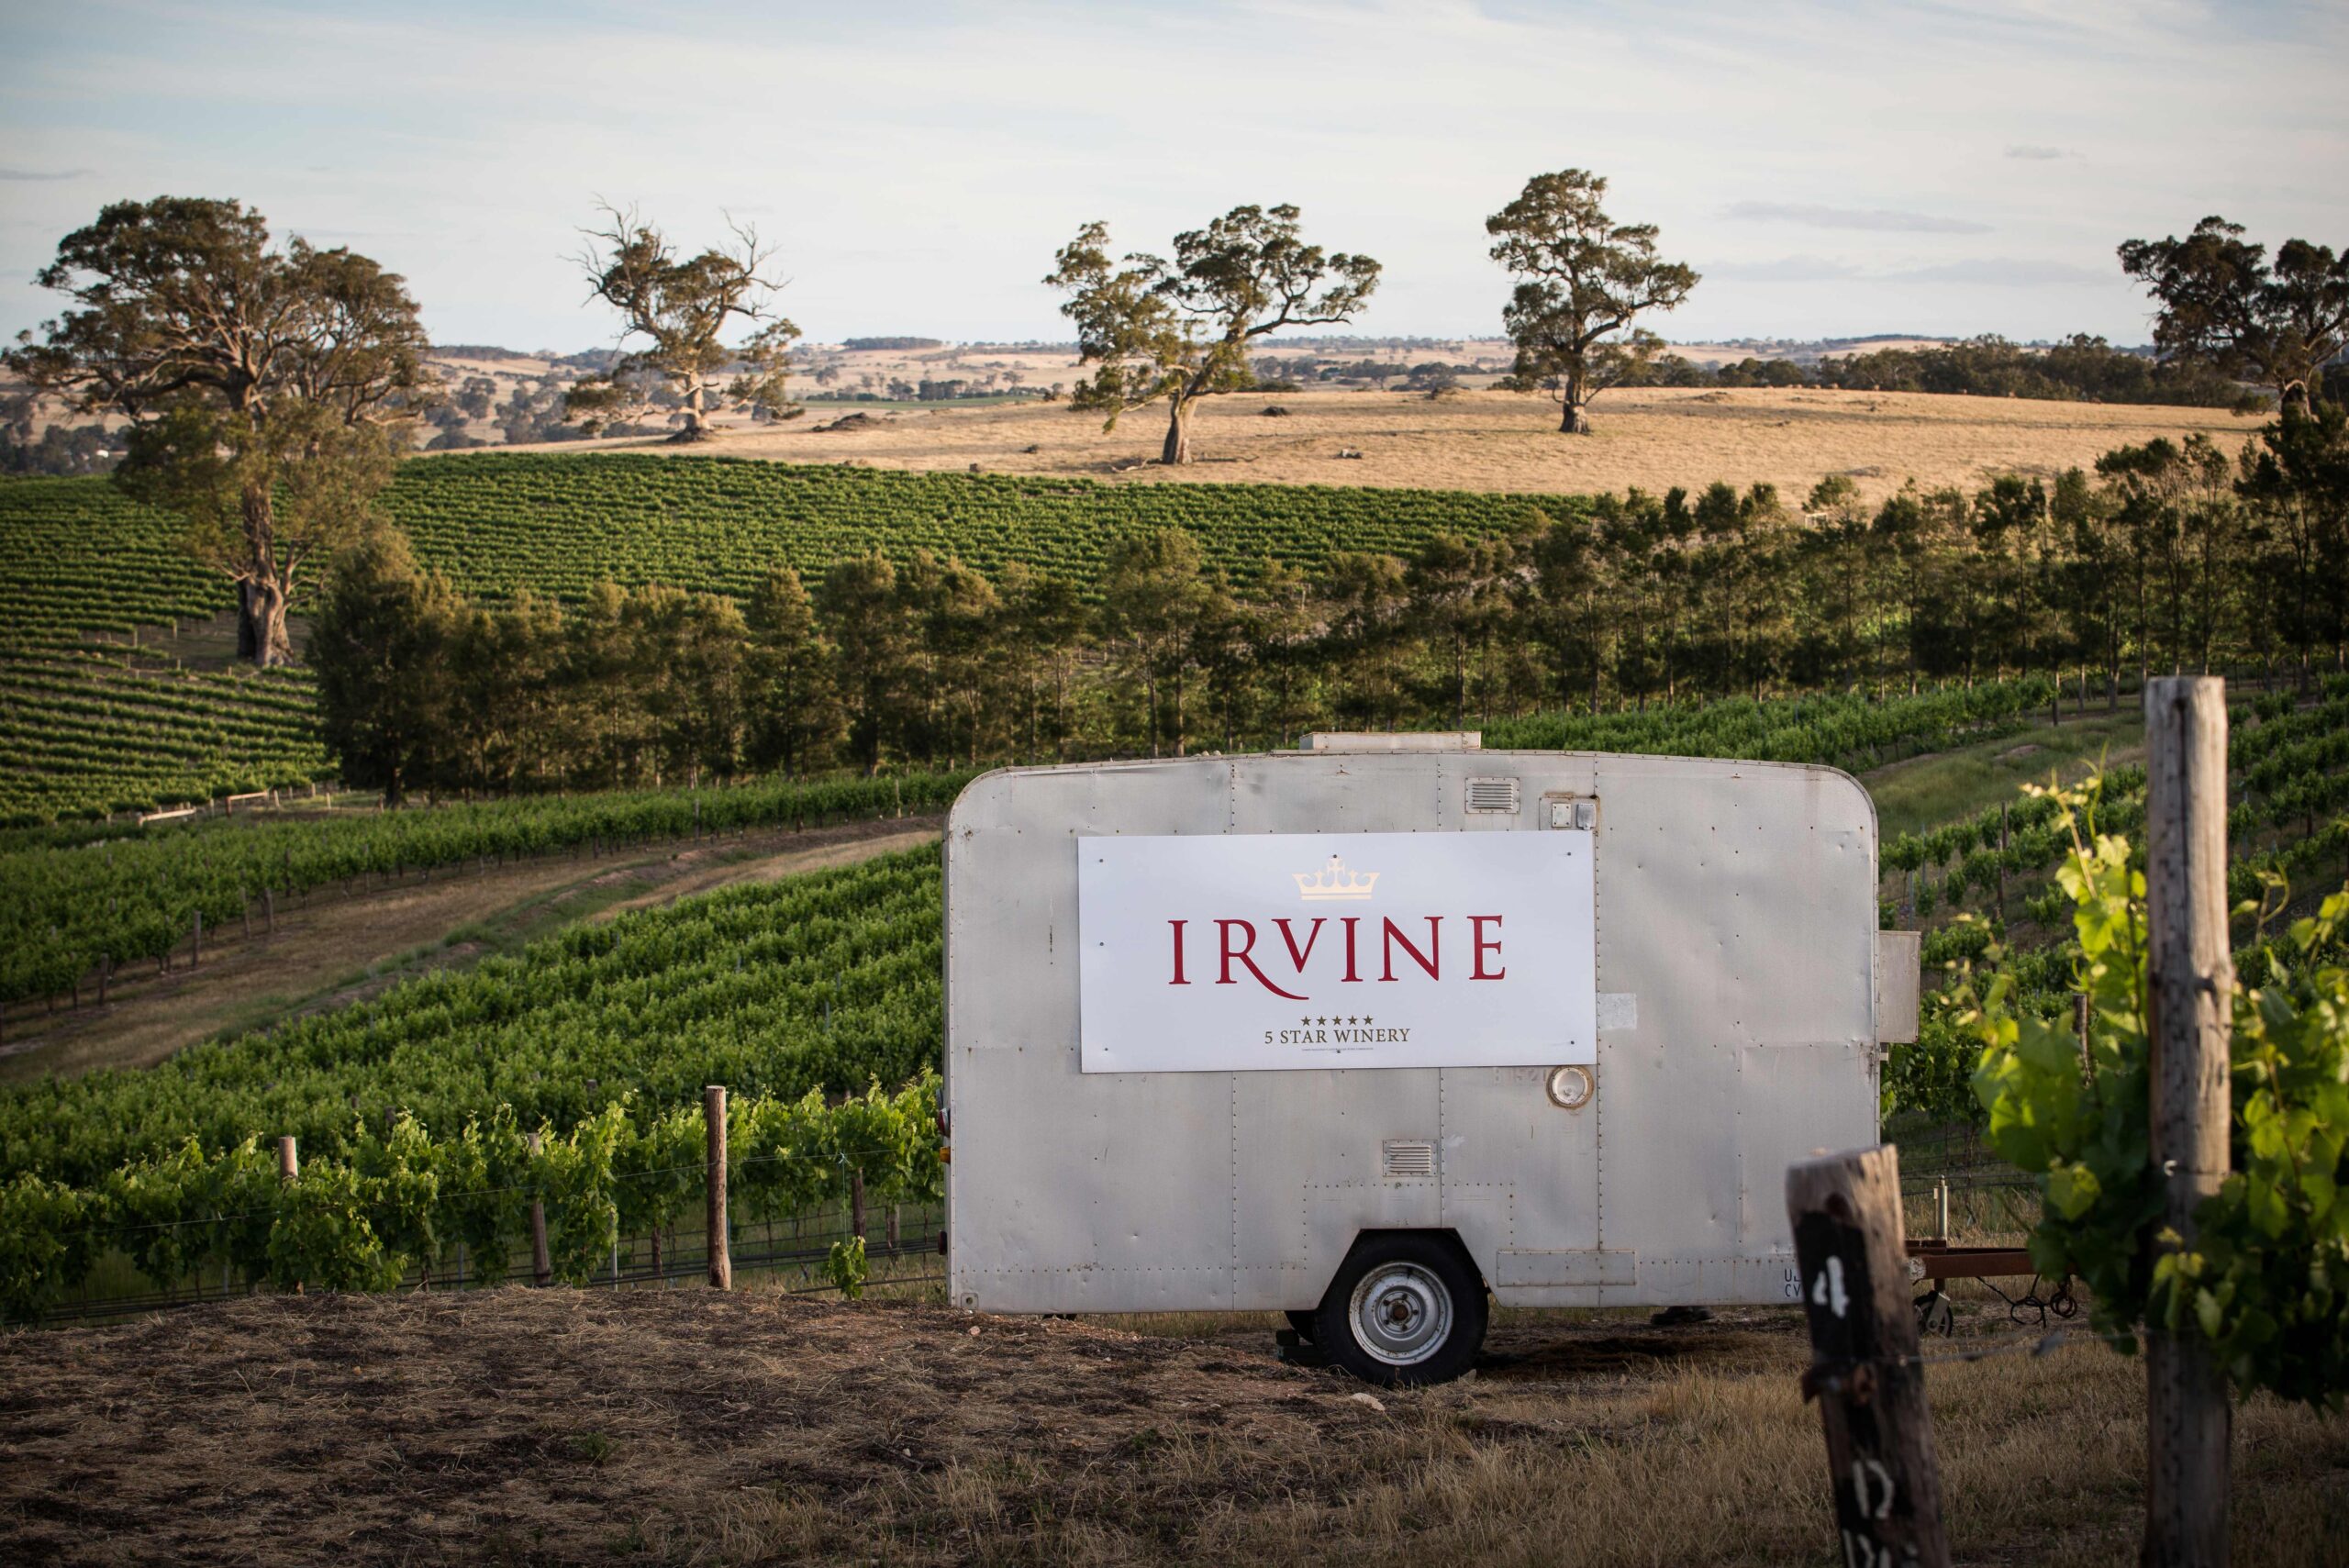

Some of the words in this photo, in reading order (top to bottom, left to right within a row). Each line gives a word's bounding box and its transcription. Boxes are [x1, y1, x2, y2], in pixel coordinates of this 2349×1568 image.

[1168, 915, 1506, 1000] IRVINE
[1264, 1031, 1273, 1044] 5
[1280, 1029, 1328, 1044] STAR
[1334, 1028, 1411, 1043] WINERY
